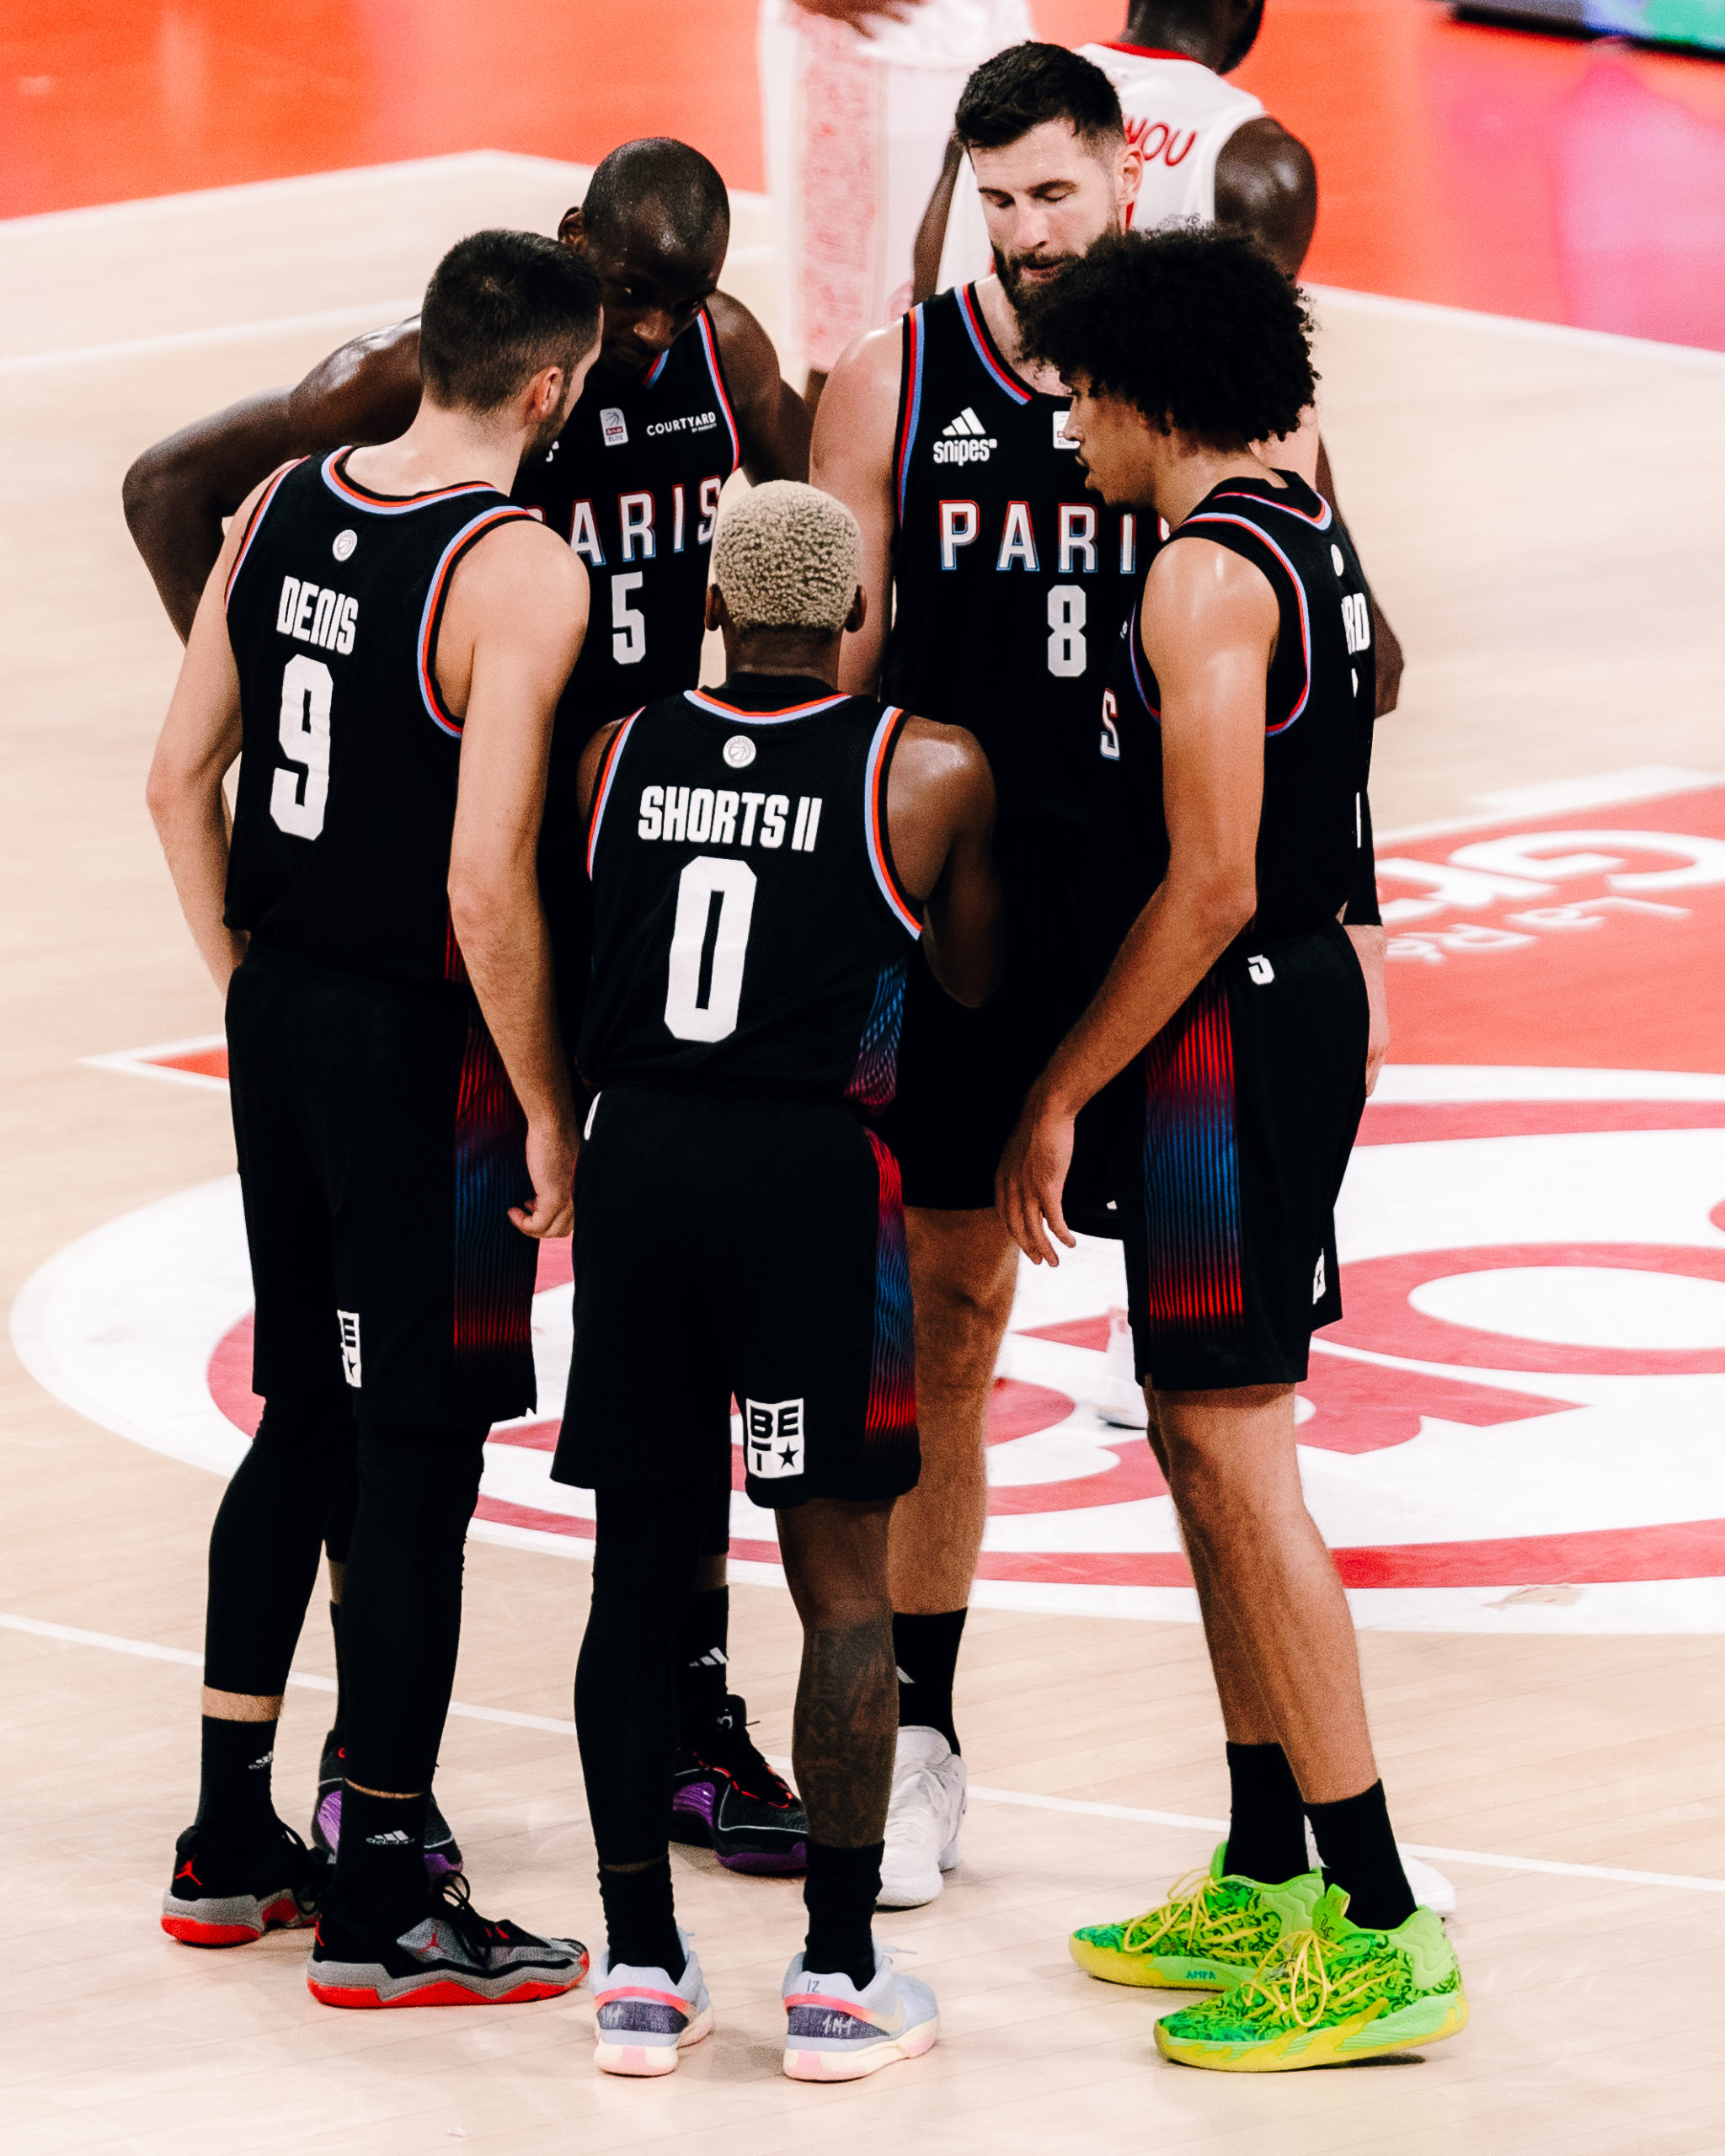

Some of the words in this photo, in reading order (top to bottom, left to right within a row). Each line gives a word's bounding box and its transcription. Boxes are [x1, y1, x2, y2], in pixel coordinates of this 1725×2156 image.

[646, 411, 716, 436] COURTYARD
[933, 439, 991, 466] snipes
[524, 475, 722, 566] ARIS
[939, 499, 1170, 574] PARI
[276, 575, 359, 655] DENIS
[611, 571, 646, 664] 5
[1047, 585, 1087, 677] 8
[1341, 592, 1371, 655] RD
[270, 654, 334, 841] 9
[638, 785, 789, 848] SHORTS
[791, 796, 822, 852] II
[664, 855, 757, 1043] 0
